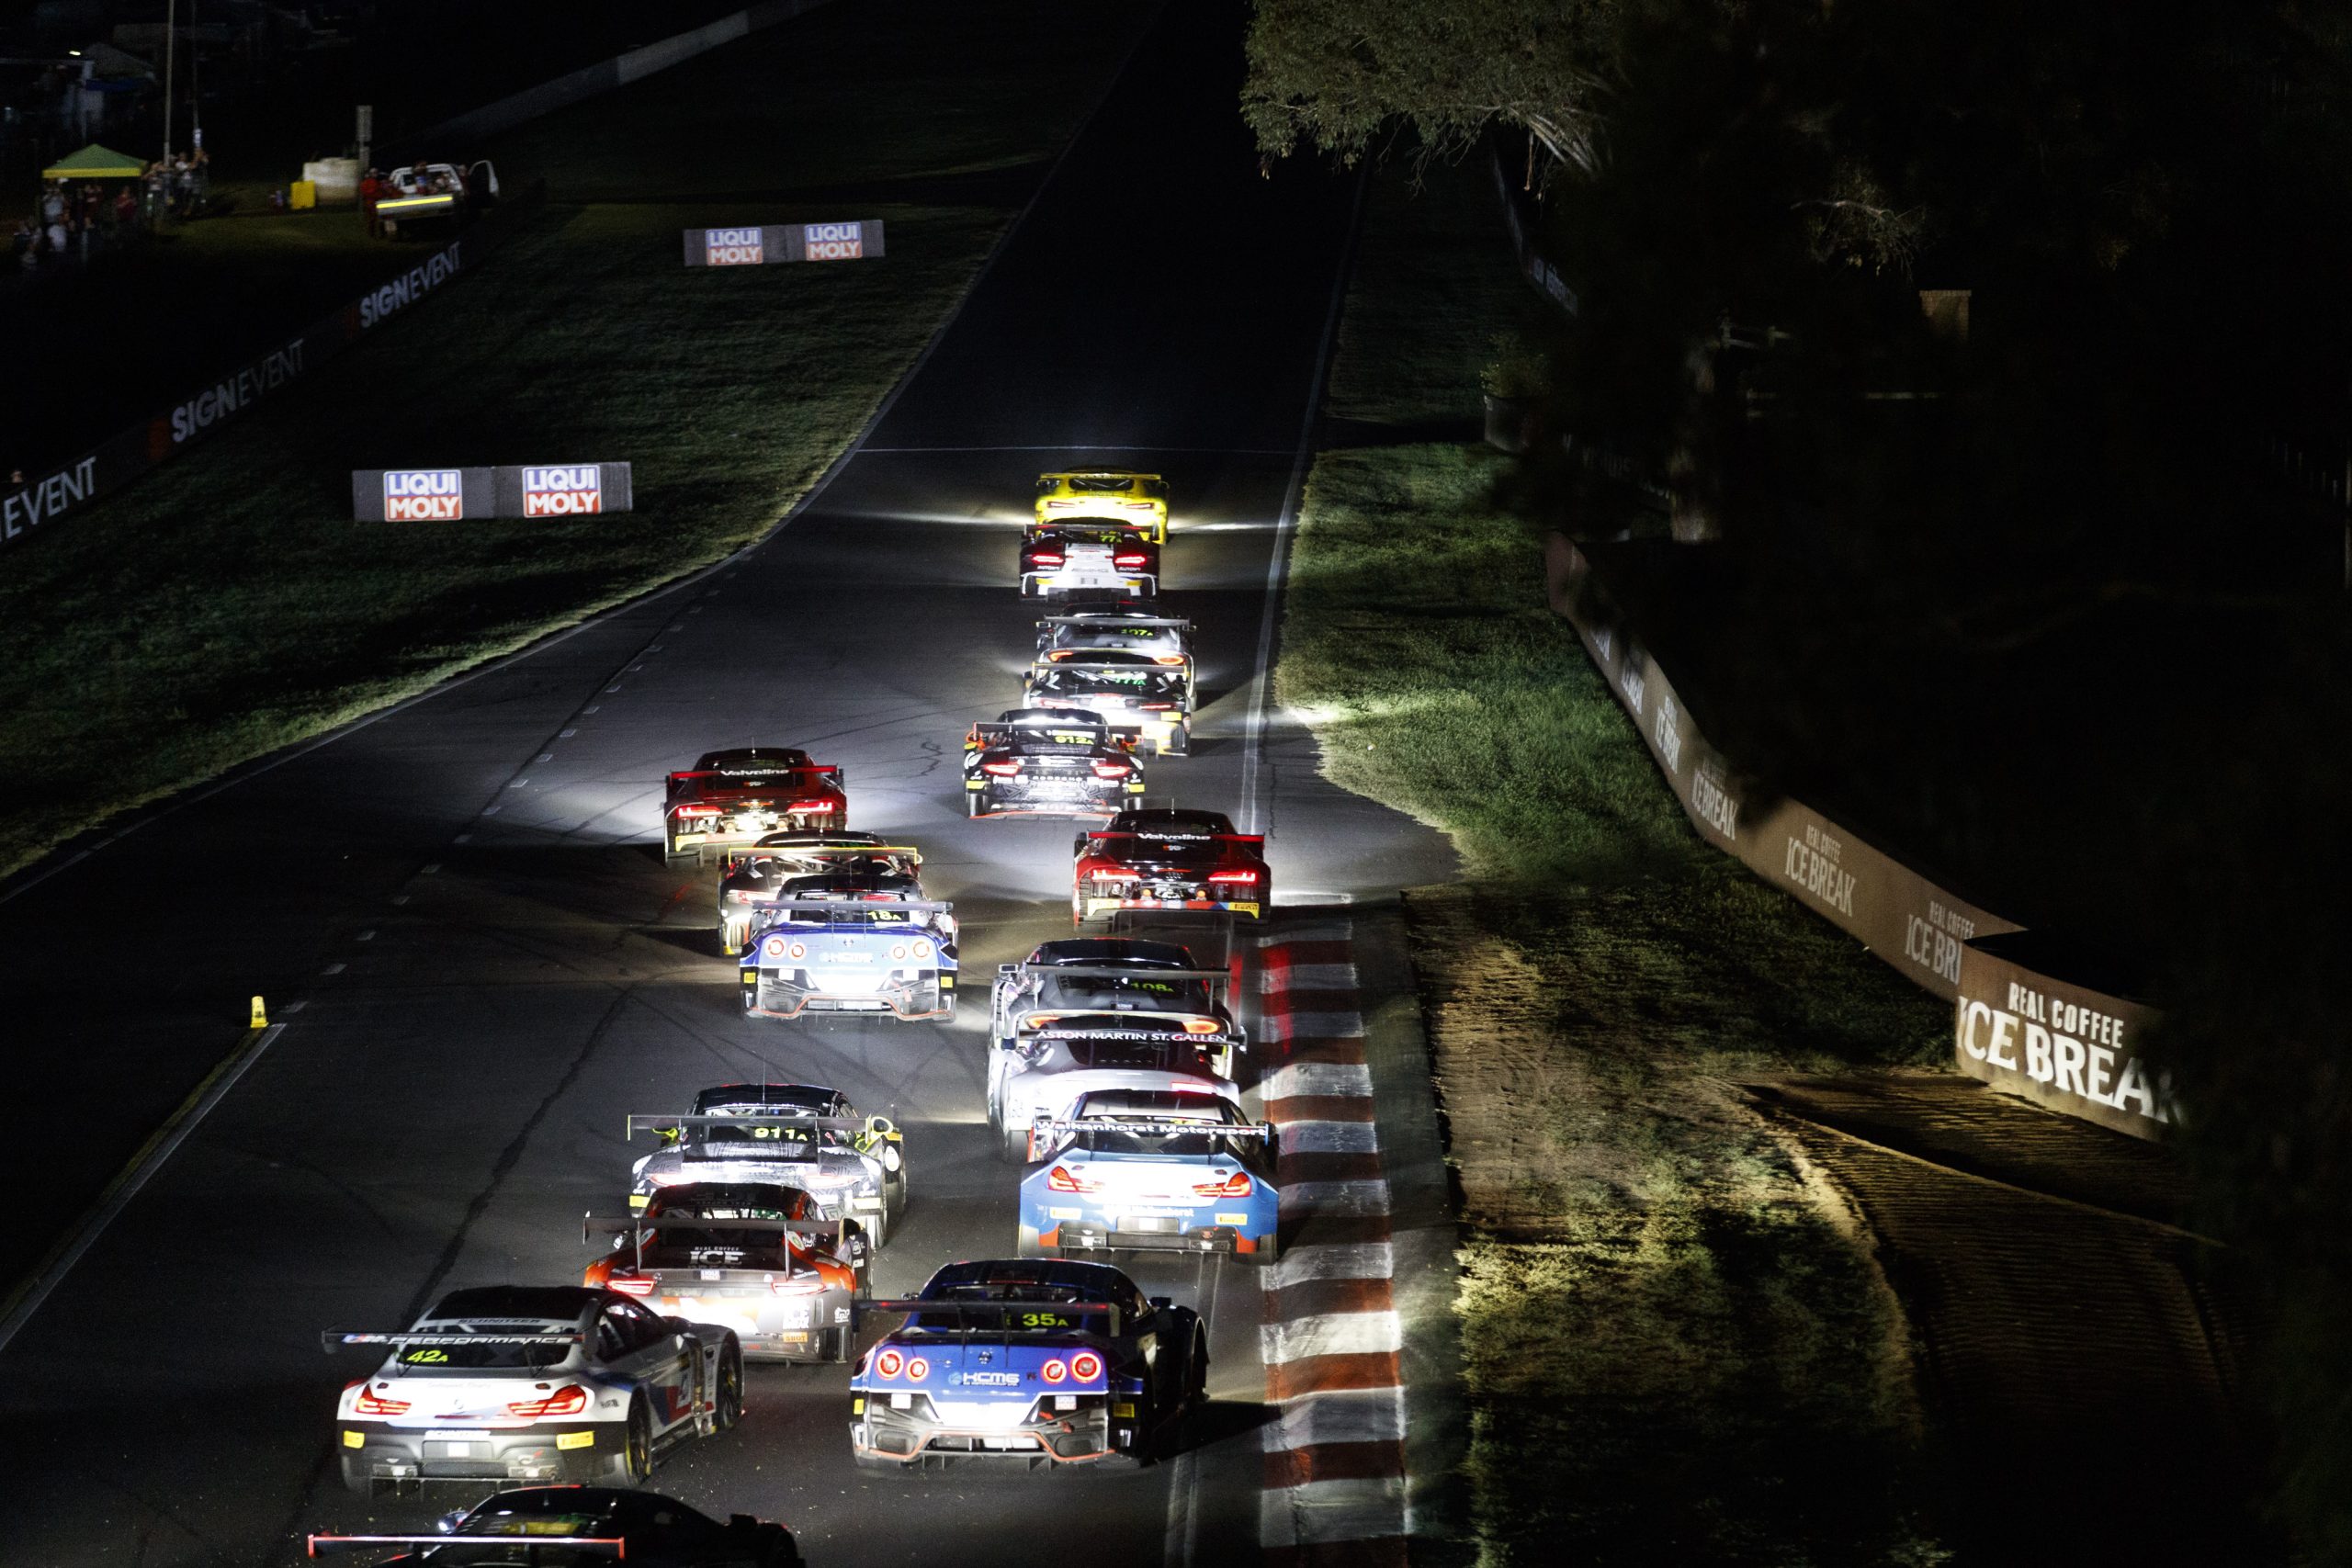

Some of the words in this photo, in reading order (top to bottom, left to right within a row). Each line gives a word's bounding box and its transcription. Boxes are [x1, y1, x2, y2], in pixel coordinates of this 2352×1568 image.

[709, 230, 759, 246] LIQUI
[808, 225, 857, 242] LIQUI
[709, 246, 761, 264] MOLY
[809, 242, 860, 258] MOLY
[388, 472, 458, 496] LIQUI
[526, 468, 596, 491] LIQUI
[388, 497, 459, 519] MOLY
[526, 491, 599, 514] MOLY
[1137, 832, 1211, 840] Valvoline
[1785, 837, 1809, 886] ICE
[1807, 851, 1857, 918] BREAK
[1905, 914, 1933, 967] ICE
[2008, 982, 2047, 1023] REAL
[2052, 999, 2124, 1049] COFFEE
[1036, 1031, 1088, 1040] ASTON
[1090, 1032, 1148, 1041] MARTIN
[1150, 1033, 1170, 1042] ST.
[1170, 1033, 1227, 1043] GALLEN
[753, 1127, 808, 1142] 911A
[1035, 1120, 1155, 1134] Walkenhorst
[1159, 1124, 1268, 1136] Motorsport
[689, 1250, 746, 1266] ICE
[1023, 1313, 1069, 1326] 35A
[388, 1337, 575, 1346] PERFORMANCE
[406, 1349, 448, 1363] 42A
